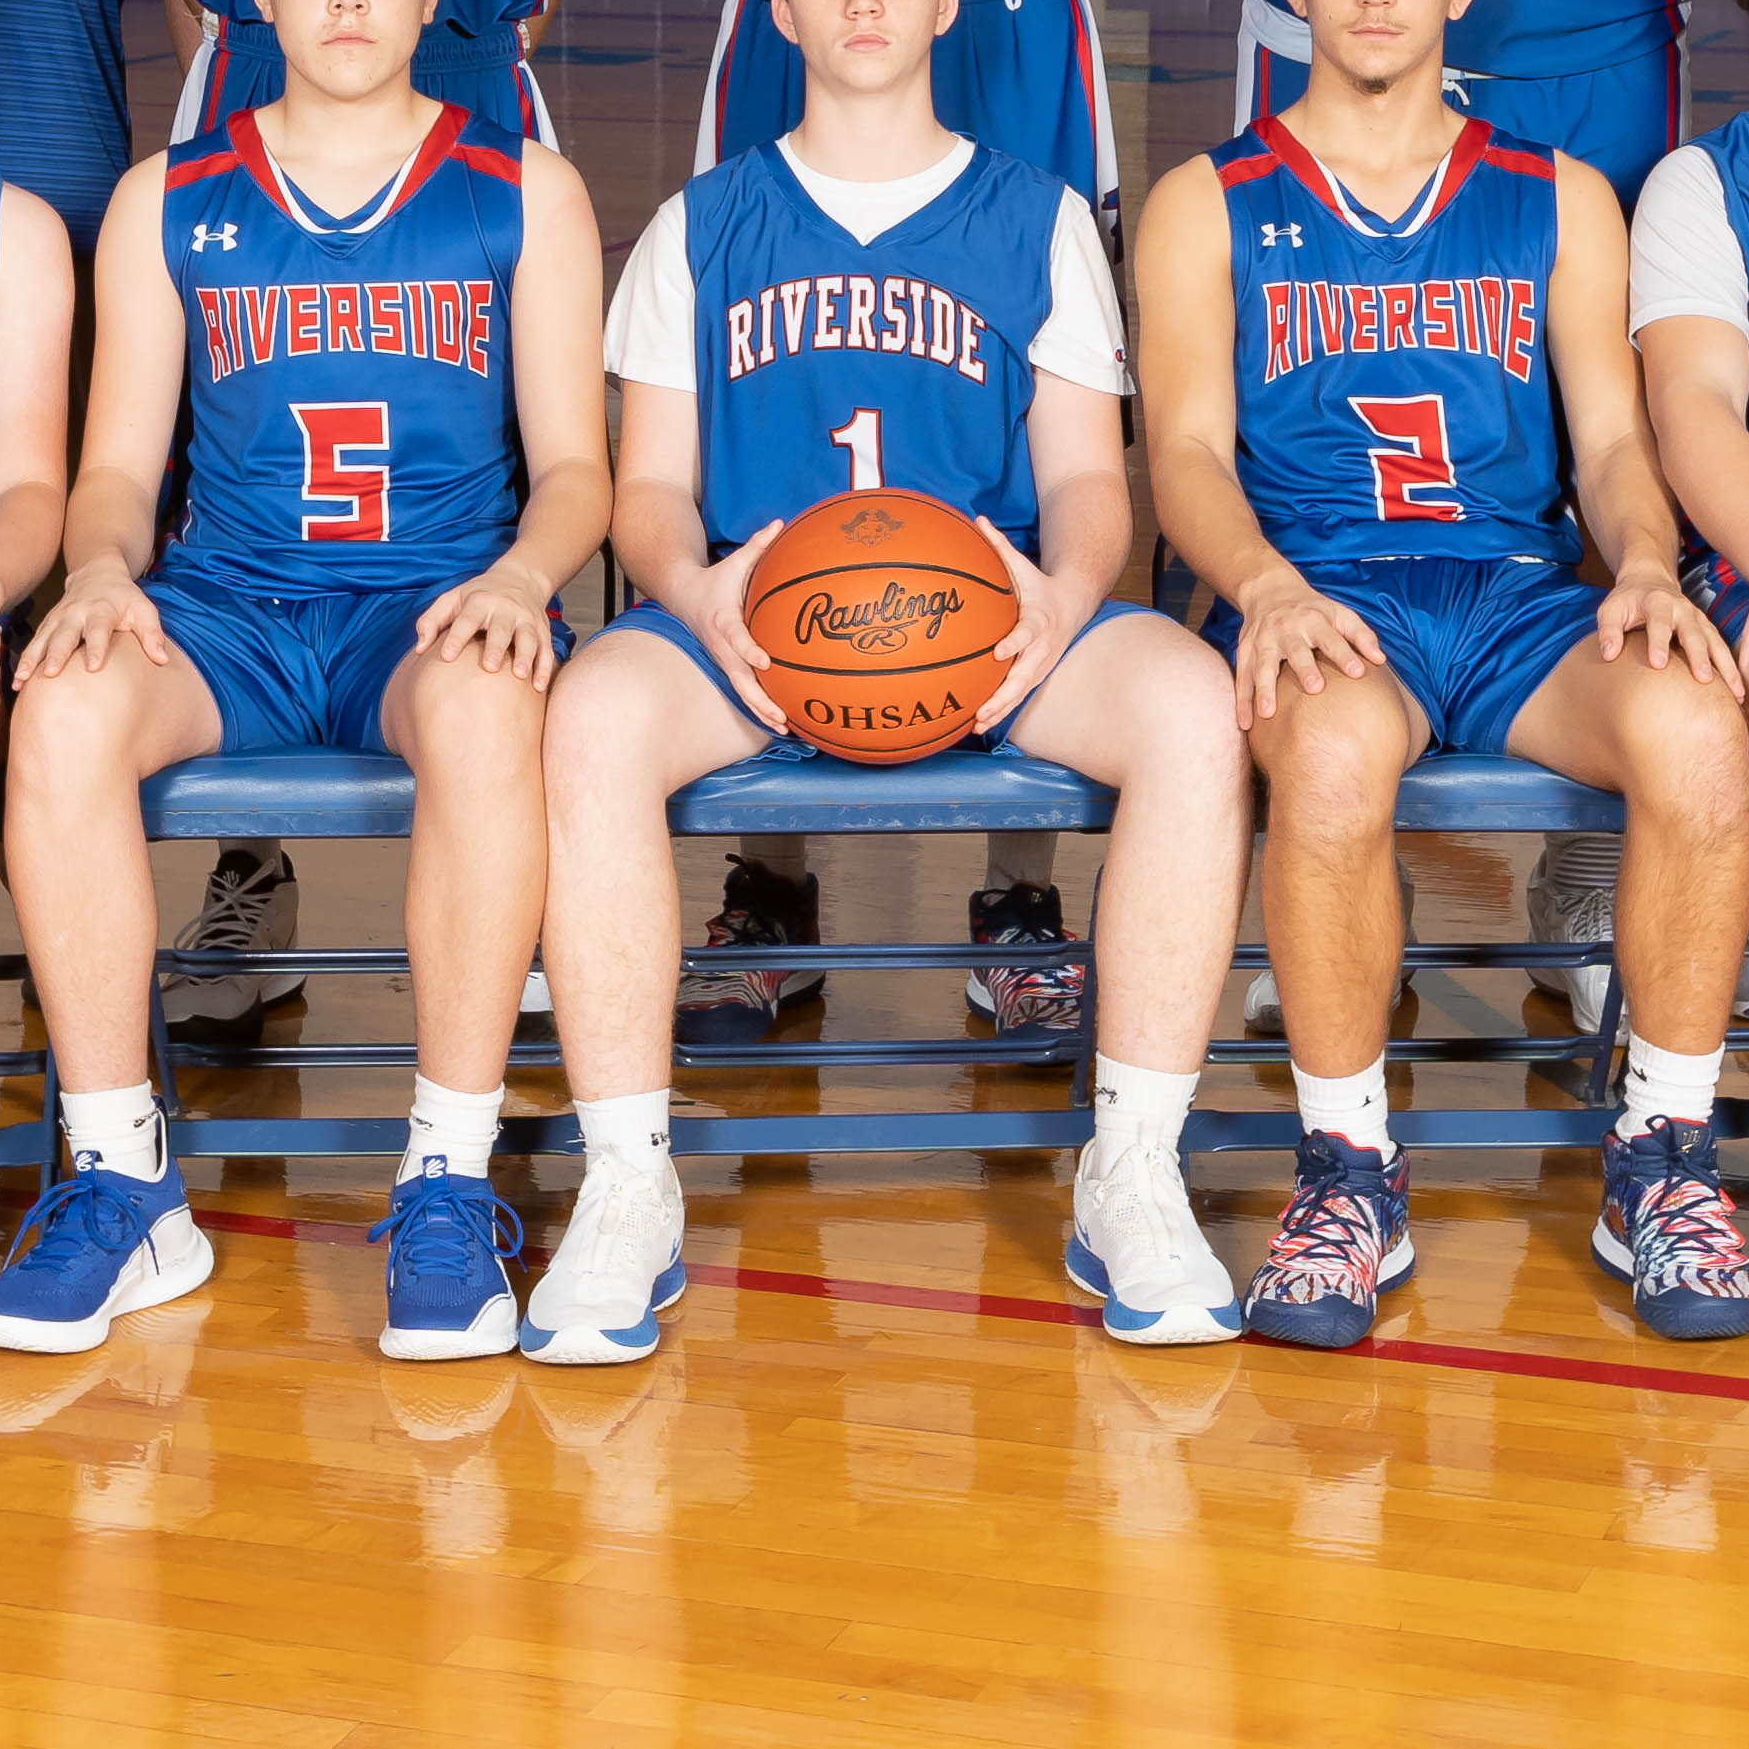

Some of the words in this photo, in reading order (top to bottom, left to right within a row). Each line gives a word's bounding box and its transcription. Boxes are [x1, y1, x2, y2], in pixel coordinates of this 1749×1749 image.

[195, 280, 493, 384] RIVERSIDE
[727, 274, 988, 387] RIVERSIDE
[1262, 276, 1536, 384] RIVERSIDE
[288, 401, 390, 543] 5
[829, 407, 884, 491] 1
[1347, 393, 1467, 522] 2
[794, 581, 965, 645] Rawlings
[803, 691, 965, 731] OHSAA
